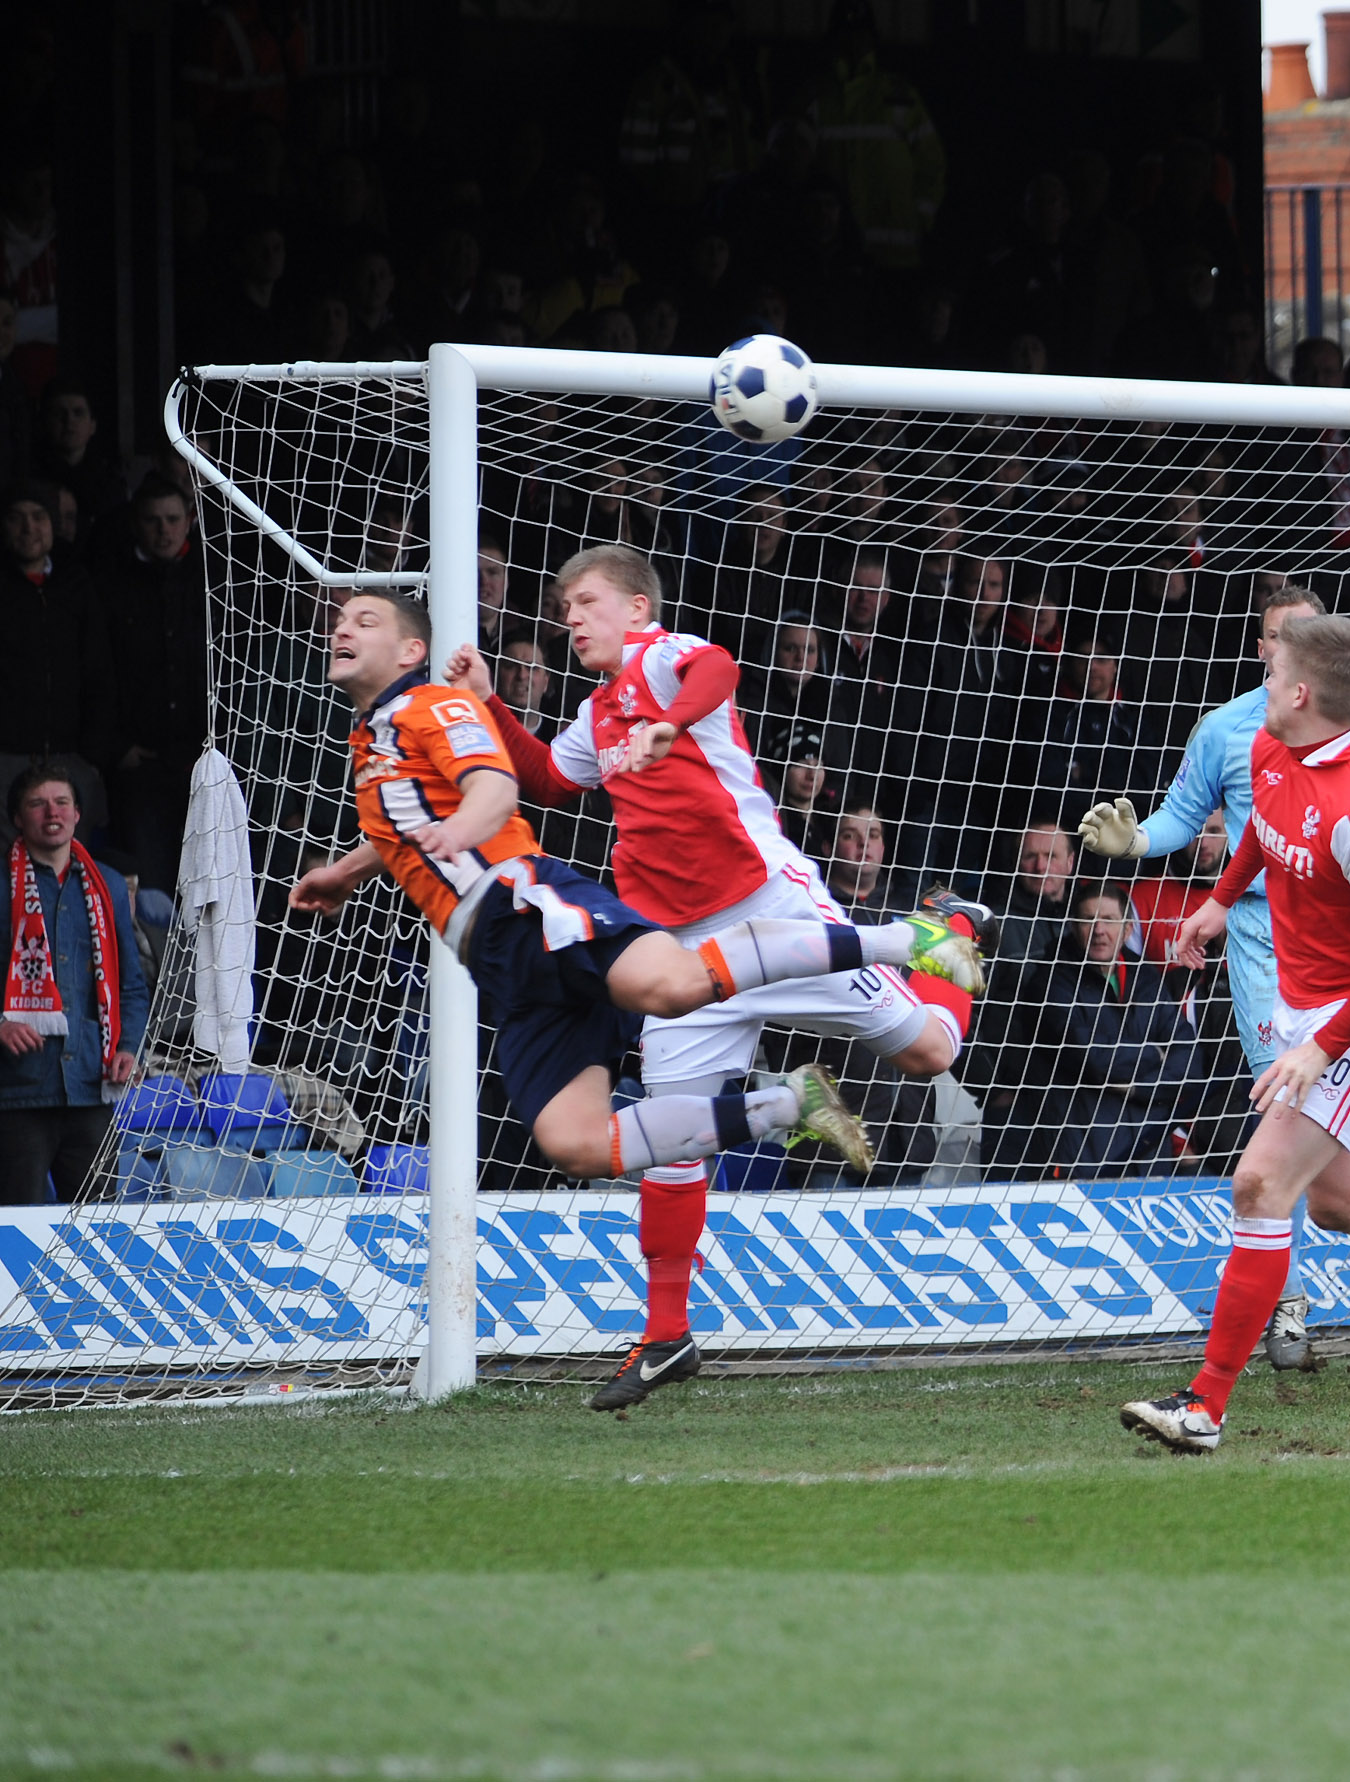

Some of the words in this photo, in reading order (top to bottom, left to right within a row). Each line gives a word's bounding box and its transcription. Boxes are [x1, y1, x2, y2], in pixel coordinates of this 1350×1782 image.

[849, 968, 882, 1001] 10
[10, 996, 54, 1010] KIDDIE
[0, 1218, 370, 1352] AIMS
